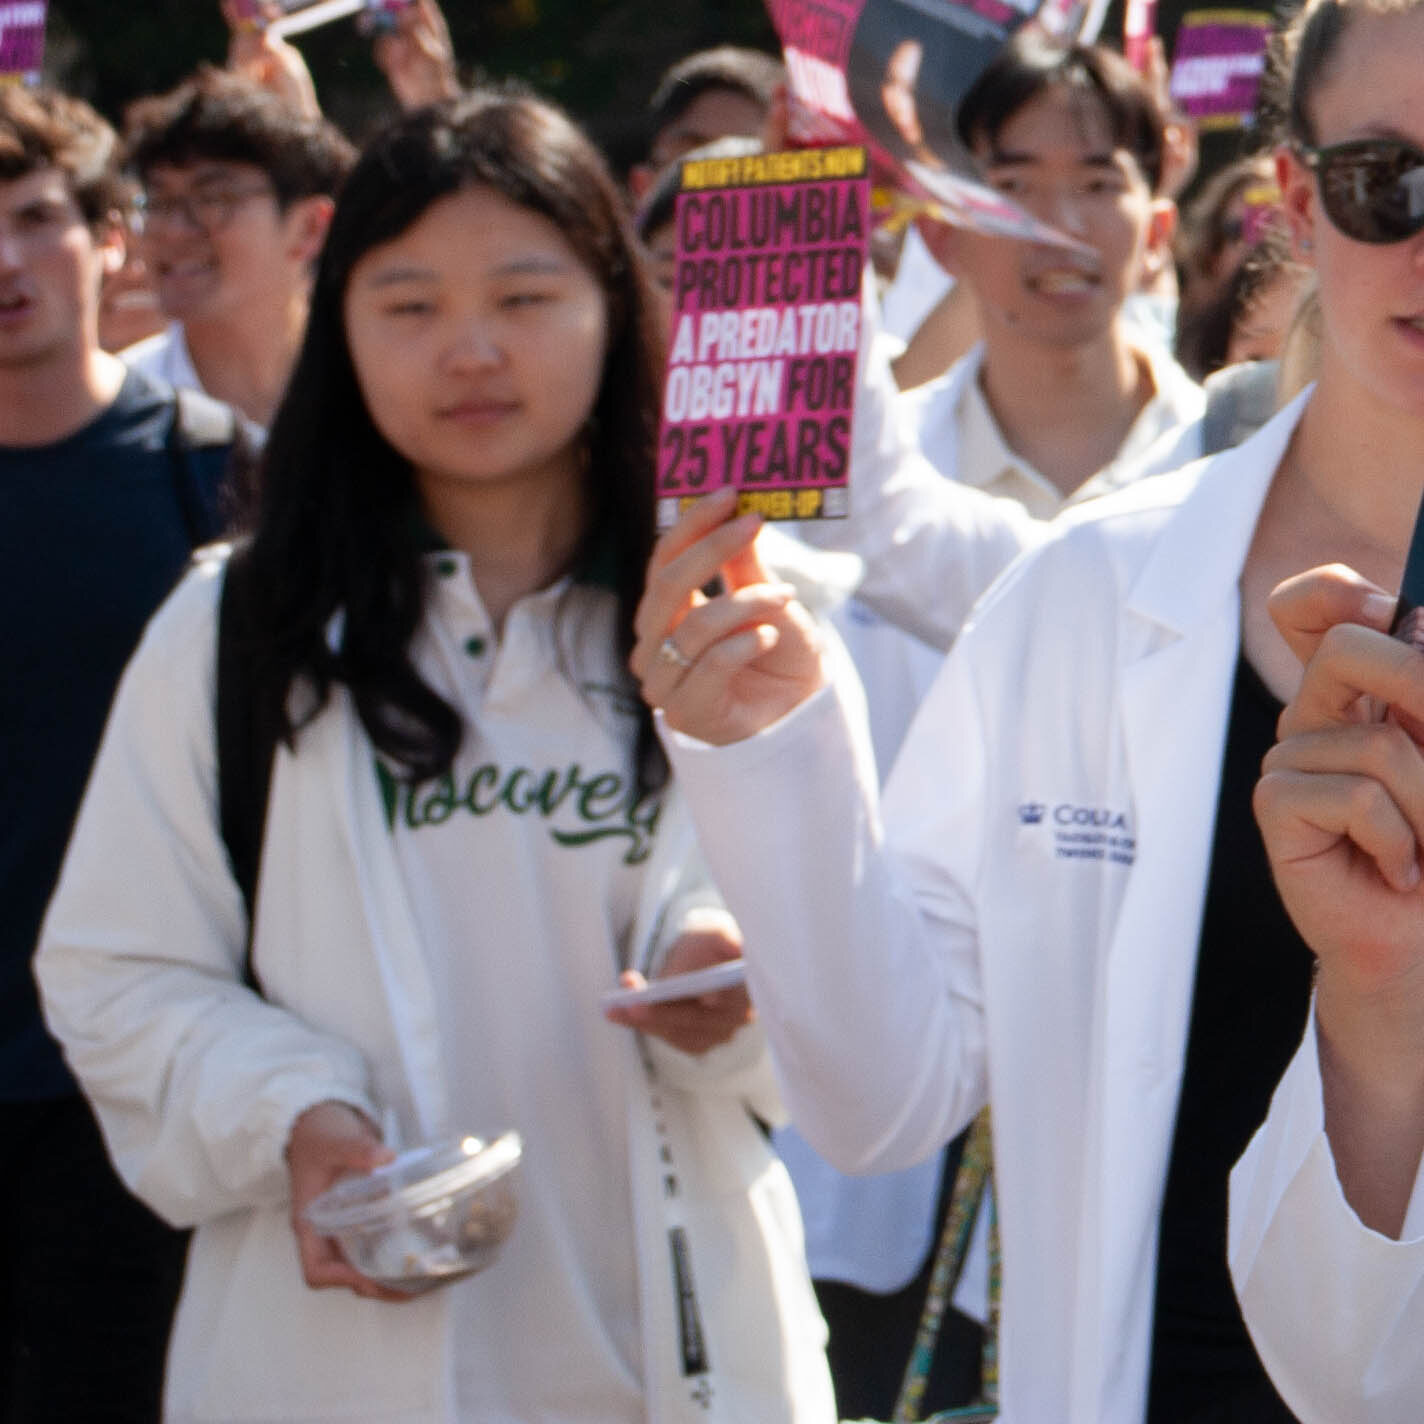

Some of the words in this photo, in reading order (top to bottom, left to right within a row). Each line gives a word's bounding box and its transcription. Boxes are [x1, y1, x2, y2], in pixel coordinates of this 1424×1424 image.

[679, 185, 863, 253] COLUMBIA
[676, 247, 862, 311] PROTECTED
[669, 313, 694, 364] A
[697, 302, 859, 362] PREDATOR
[664, 359, 782, 424] OBGYN
[785, 356, 854, 413] FOR
[660, 425, 711, 488] 25
[720, 416, 850, 485] YEARS
